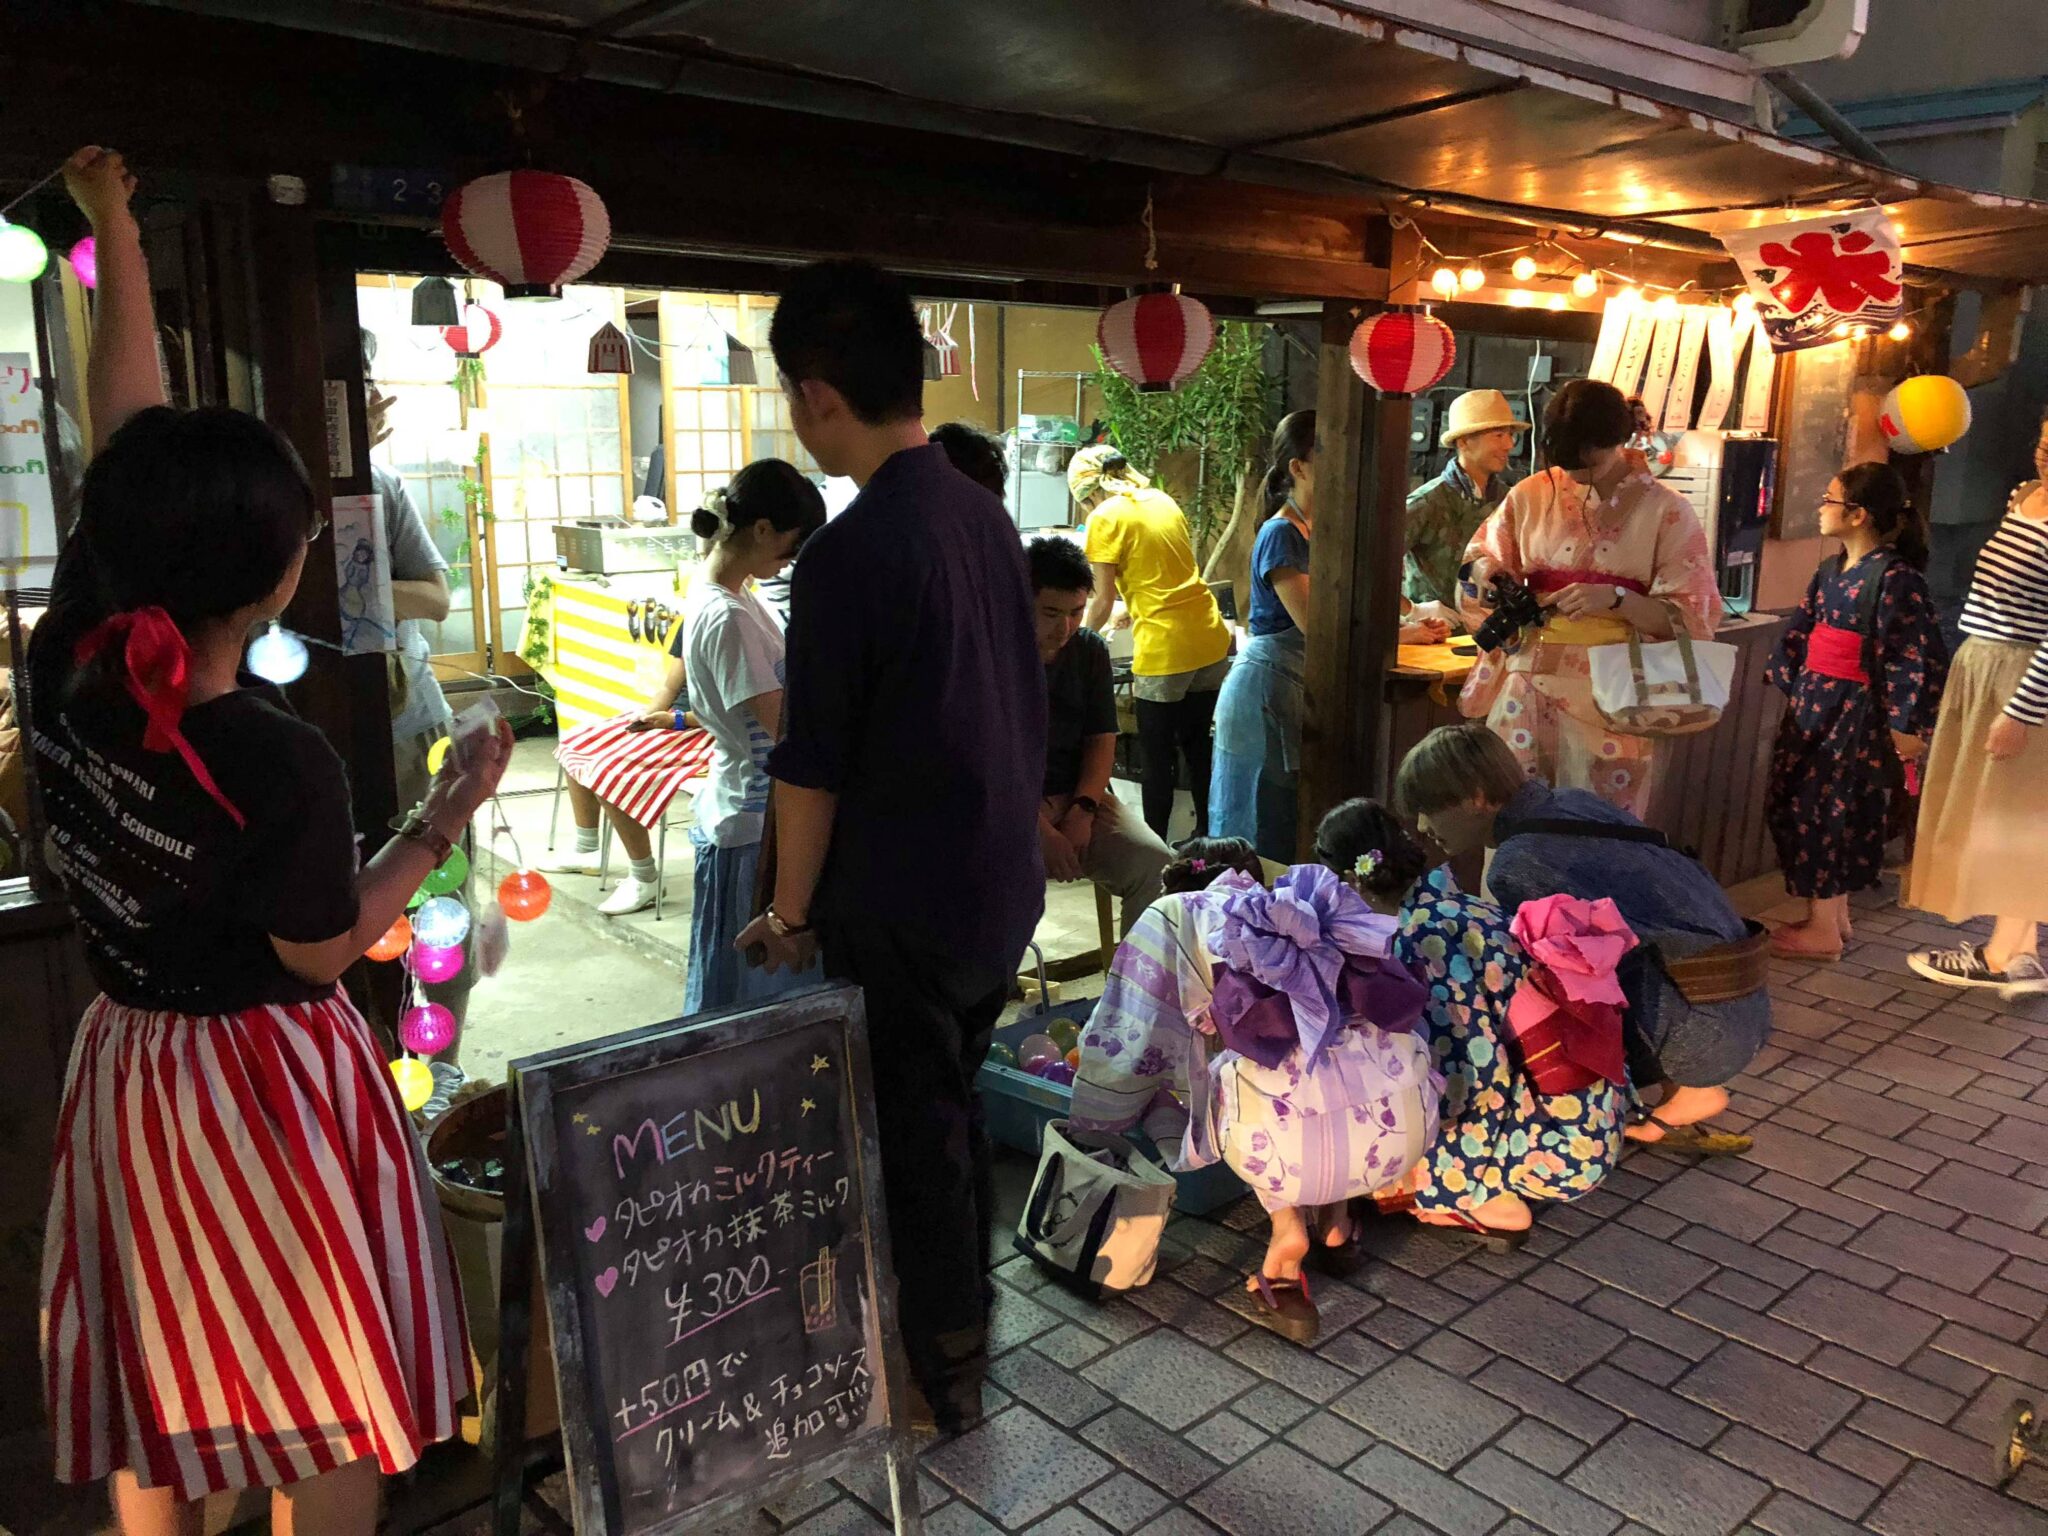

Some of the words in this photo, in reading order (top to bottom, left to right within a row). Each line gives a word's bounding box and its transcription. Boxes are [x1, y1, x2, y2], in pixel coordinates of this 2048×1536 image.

[73, 763, 119, 818] FESTIVAL
[120, 811, 197, 861] SCHEDULE
[613, 1088, 762, 1180] MENU
[615, 1146, 835, 1240] タピオカミルクティー
[622, 1176, 850, 1288] タピオカ抹茶ミルク
